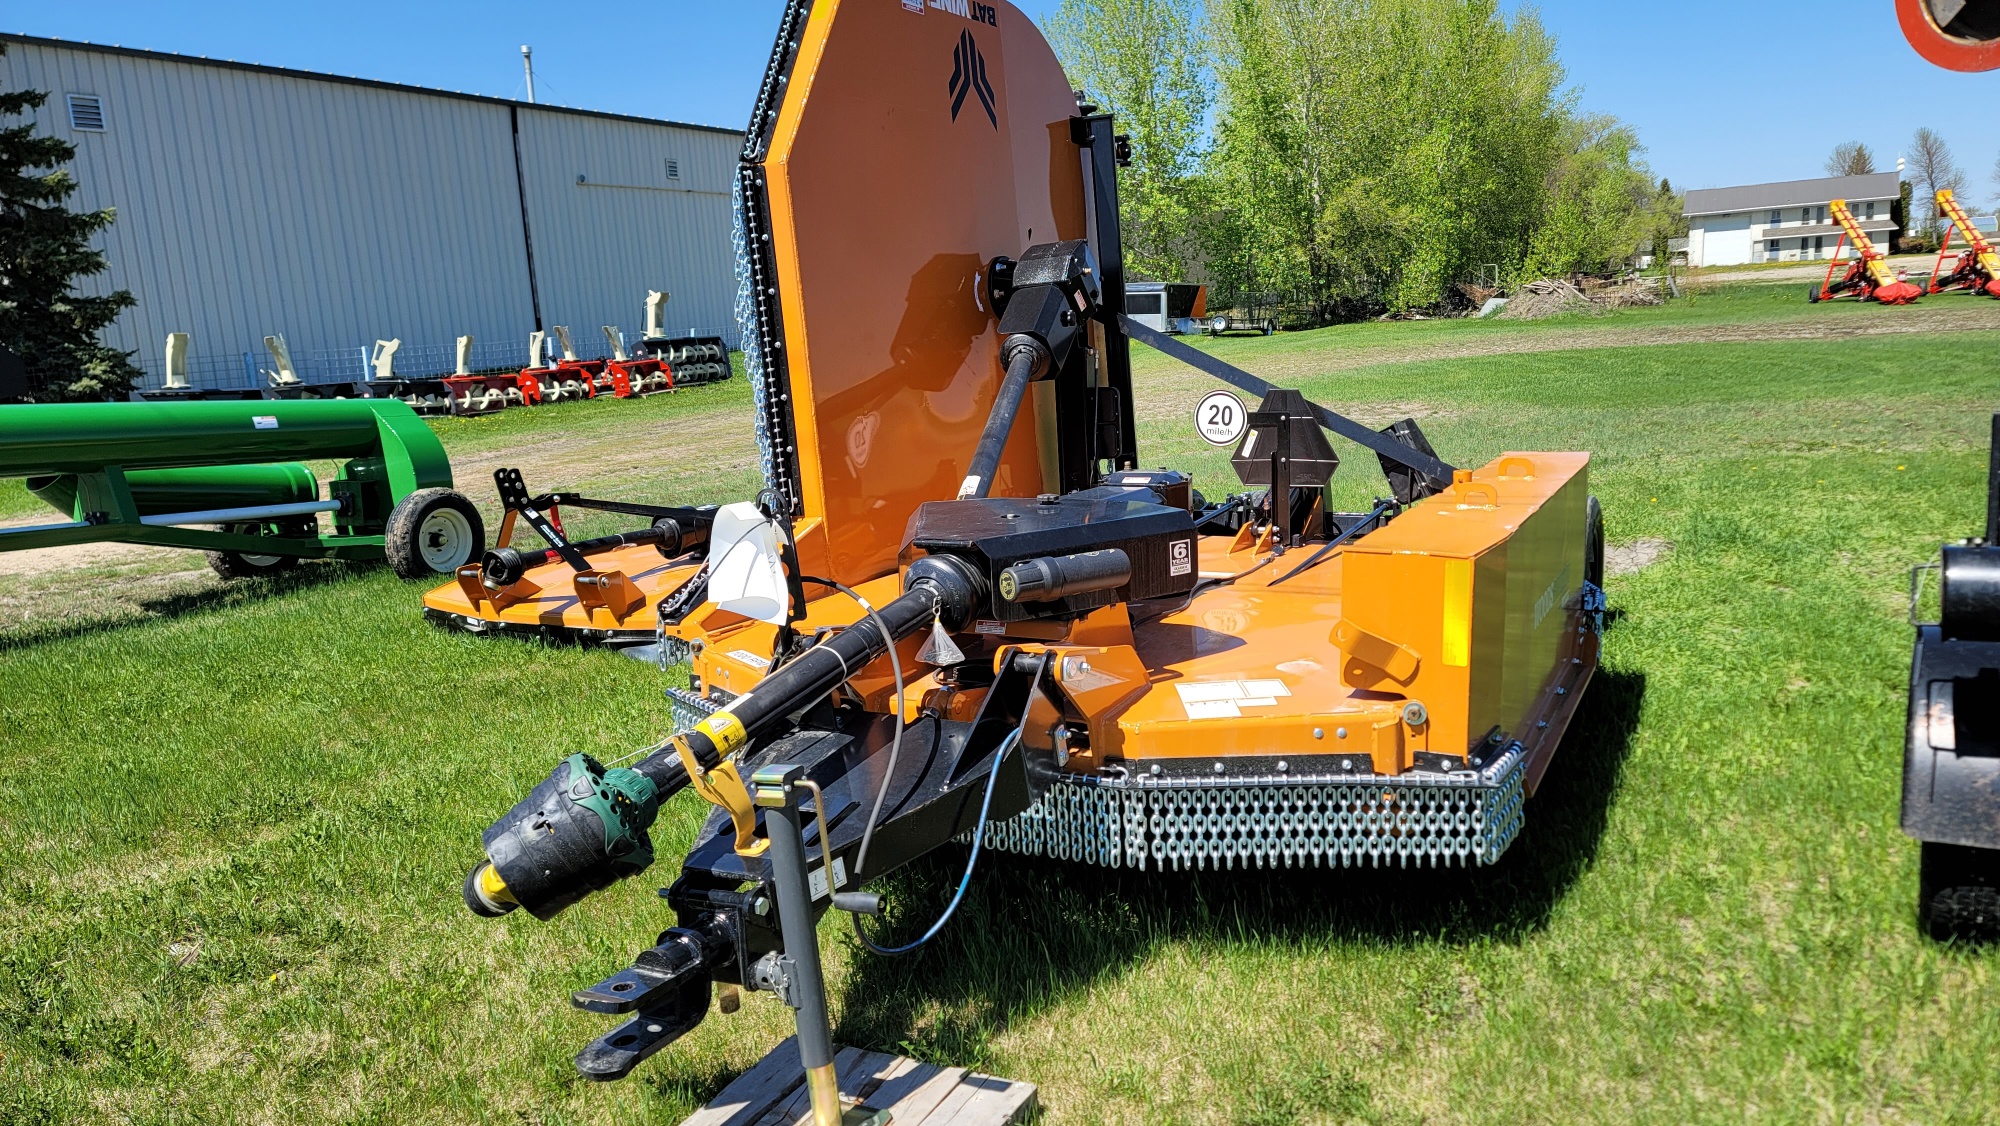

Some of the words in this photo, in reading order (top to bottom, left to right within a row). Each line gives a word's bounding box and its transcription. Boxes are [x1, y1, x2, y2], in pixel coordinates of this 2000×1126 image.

[1208, 404, 1233, 426] 20
[1206, 428, 1233, 436] mile/h
[1173, 543, 1187, 559] 6
[1172, 557, 1189, 566] YEAR
